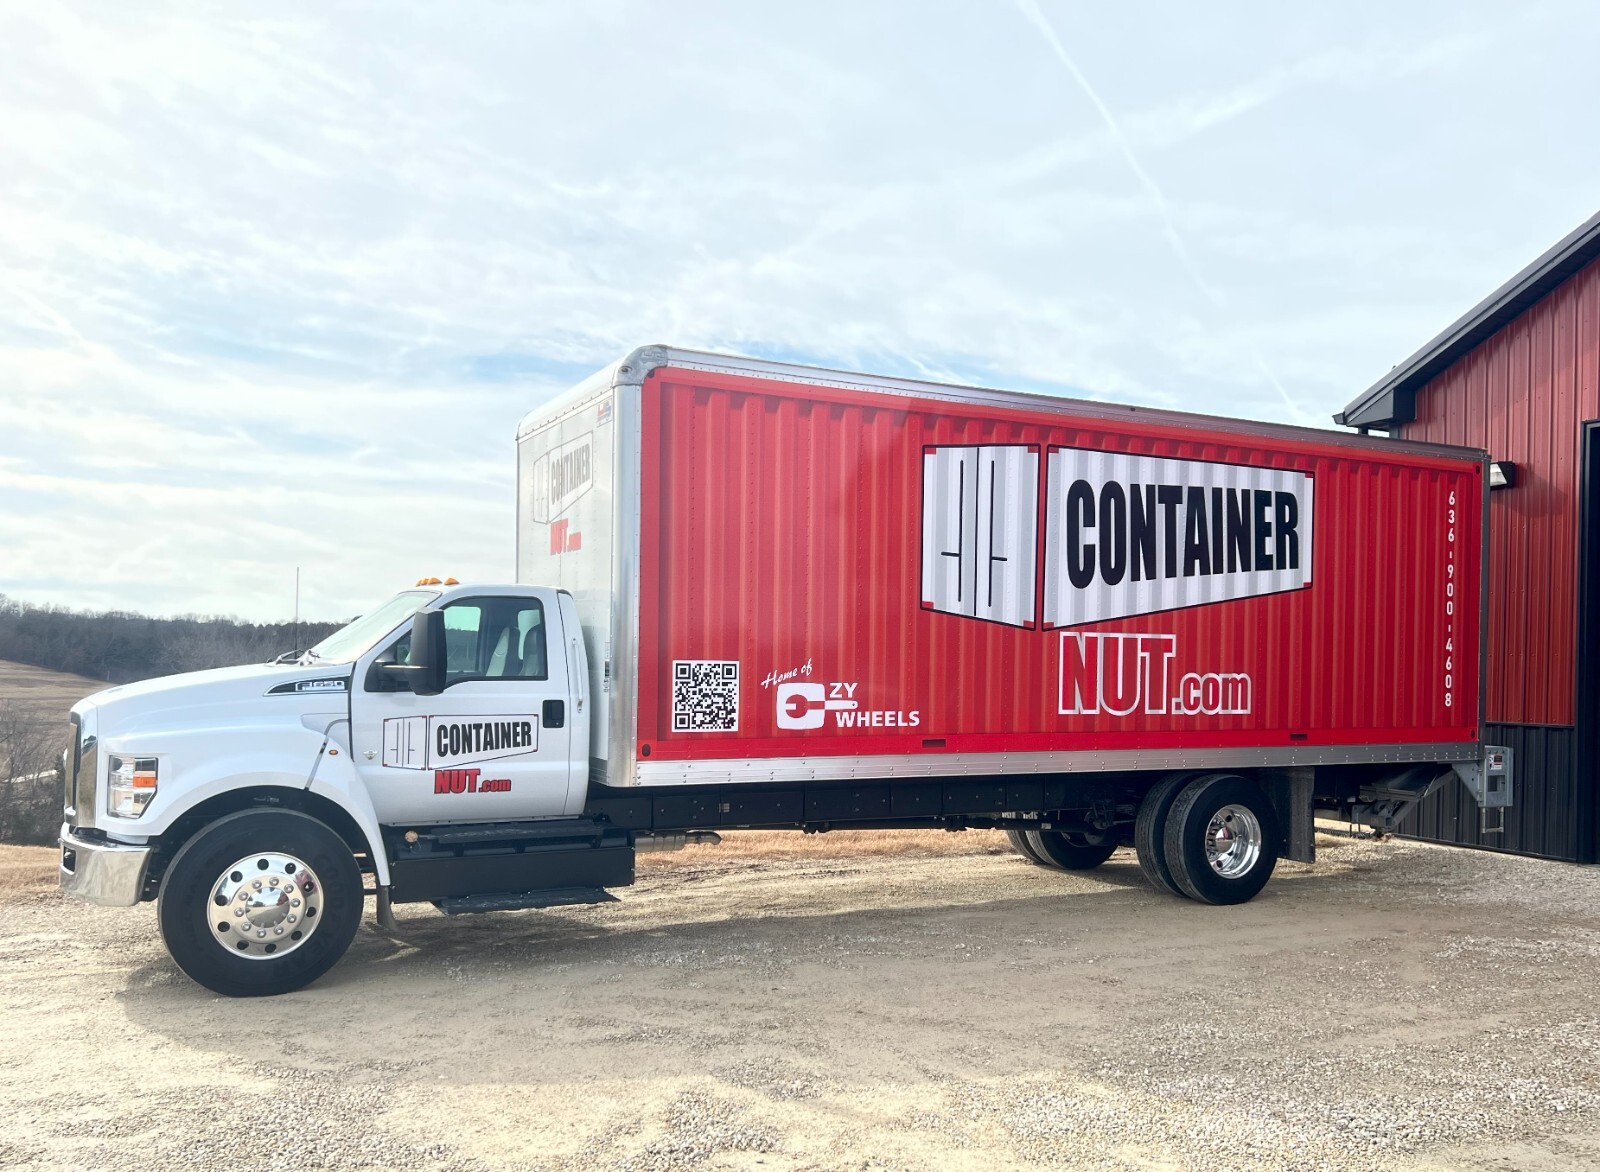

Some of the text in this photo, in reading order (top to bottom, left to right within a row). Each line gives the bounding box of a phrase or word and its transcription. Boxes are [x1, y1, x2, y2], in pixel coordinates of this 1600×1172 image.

[551, 443, 591, 505] CONTAINER
[1066, 479, 1299, 589] CONTAINER
[1444, 491, 1456, 707] 636-900-4608
[760, 657, 813, 690] Home of
[1058, 631, 1252, 717] NUT.com
[436, 721, 532, 757] CONTAINER
[835, 710, 920, 728] WHEELS
[434, 768, 512, 794] NUT.com
